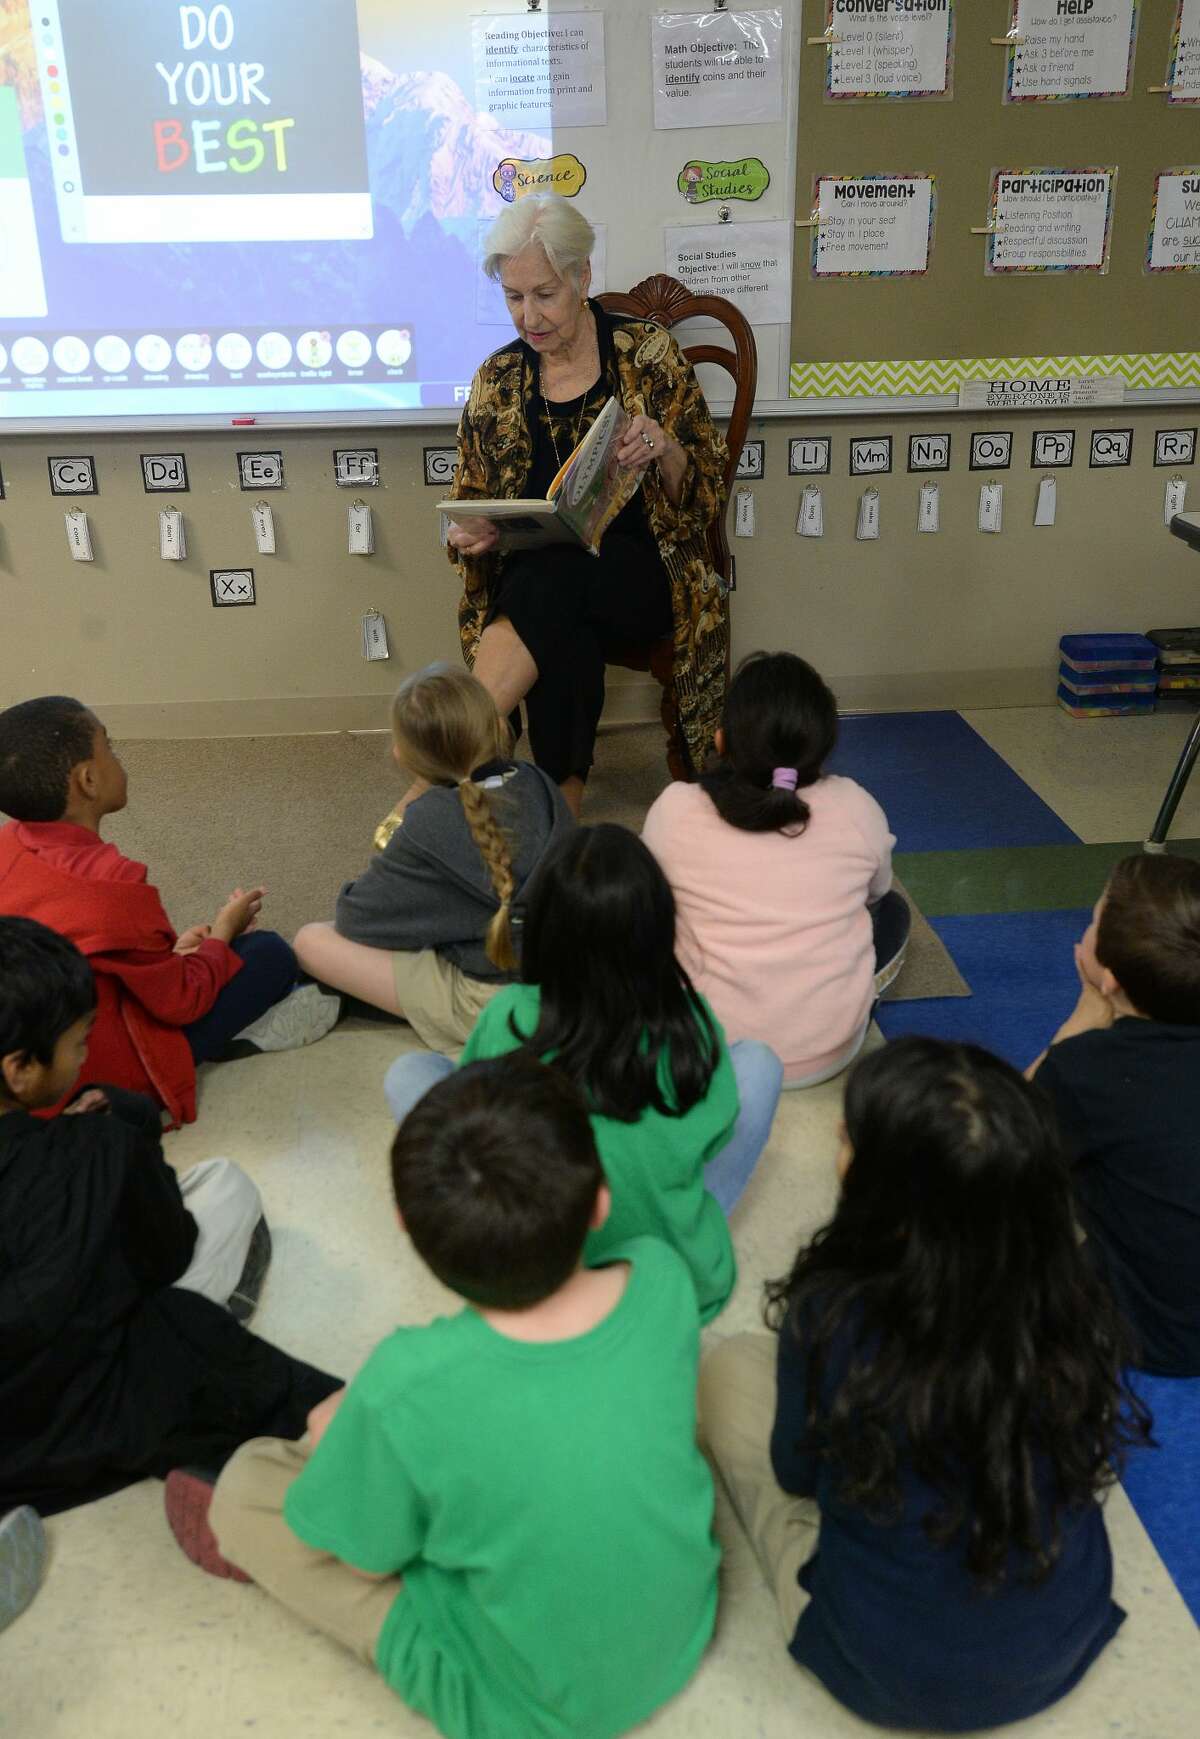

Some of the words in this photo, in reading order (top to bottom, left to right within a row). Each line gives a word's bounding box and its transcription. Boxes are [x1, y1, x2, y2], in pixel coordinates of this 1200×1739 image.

[179, 4, 234, 50] DO
[841, 32, 865, 42] Level
[1024, 35, 1047, 45] Raise
[1050, 36, 1061, 44] my
[1064, 33, 1085, 43] hand
[580, 42, 590, 50] of
[665, 45, 687, 54] Math
[690, 43, 737, 54] Objective:
[744, 41, 760, 50] The
[840, 47, 864, 56] Level
[1024, 49, 1039, 59] Ask
[1050, 48, 1081, 58] before
[1082, 49, 1094, 57] me
[665, 60, 702, 69] students
[735, 56, 753, 65] able
[755, 56, 764, 64] to
[840, 61, 864, 70] Level
[865, 60, 872, 69] 2
[1023, 63, 1038, 73] Ask
[1040, 64, 1046, 72] a
[1049, 62, 1075, 71] friend
[155, 61, 271, 106] YOUR
[510, 74, 535, 84] locate
[552, 72, 570, 82] gain
[665, 74, 700, 85] identify
[702, 73, 726, 82] coins
[728, 71, 744, 80] and
[746, 70, 767, 79] their
[840, 74, 864, 84] Level
[865, 74, 871, 83] 3
[1022, 77, 1038, 87] Use
[1040, 76, 1061, 86] hand
[1064, 76, 1092, 88] signals
[488, 87, 534, 97] information
[536, 86, 555, 95] from
[556, 85, 576, 95] print
[578, 84, 593, 93] and
[666, 89, 692, 98] value.
[488, 102, 518, 112] graphic
[153, 118, 295, 174] BEST
[706, 164, 750, 179] Social
[518, 169, 575, 187] Science
[702, 182, 753, 196] Studies
[828, 216, 846, 225] Stay
[848, 216, 855, 225] in
[858, 217, 875, 225] your
[879, 216, 897, 224] seat
[1005, 211, 1040, 221] Listening
[1042, 210, 1073, 219] Position
[827, 230, 845, 239] Stay
[848, 230, 854, 238] in
[863, 228, 886, 239] place
[1004, 224, 1035, 234] Reading
[1036, 224, 1052, 232] and
[1054, 224, 1081, 234] writing
[826, 242, 846, 251] Free
[848, 242, 889, 251] movement
[1004, 236, 1045, 247] Respectful
[1047, 236, 1088, 245] discussion
[1162, 237, 1179, 247] are
[678, 253, 703, 262] Social
[706, 250, 737, 260] Studies
[1003, 250, 1026, 259] Group
[1174, 253, 1190, 262] our
[726, 262, 739, 270] will
[763, 259, 778, 267] that
[711, 275, 729, 283] from
[731, 274, 751, 282] other
[716, 287, 735, 295] have
[737, 284, 769, 293] different
[988, 380, 1071, 393] HOME
[988, 392, 1055, 401] EVERYONE
[986, 399, 1069, 407] WELCOME
[918, 442, 943, 460] Nn
[978, 441, 1003, 458] Oo
[1042, 437, 1065, 460] Pp
[1095, 438, 1125, 458] Qq
[1164, 438, 1189, 456] Rr
[857, 449, 885, 464] Mm
[152, 462, 180, 481] Dd
[250, 460, 274, 479] Ee
[346, 458, 370, 474] Ff
[58, 466, 87, 483] Cc
[73, 528, 81, 546] come
[222, 579, 248, 595] Xx
